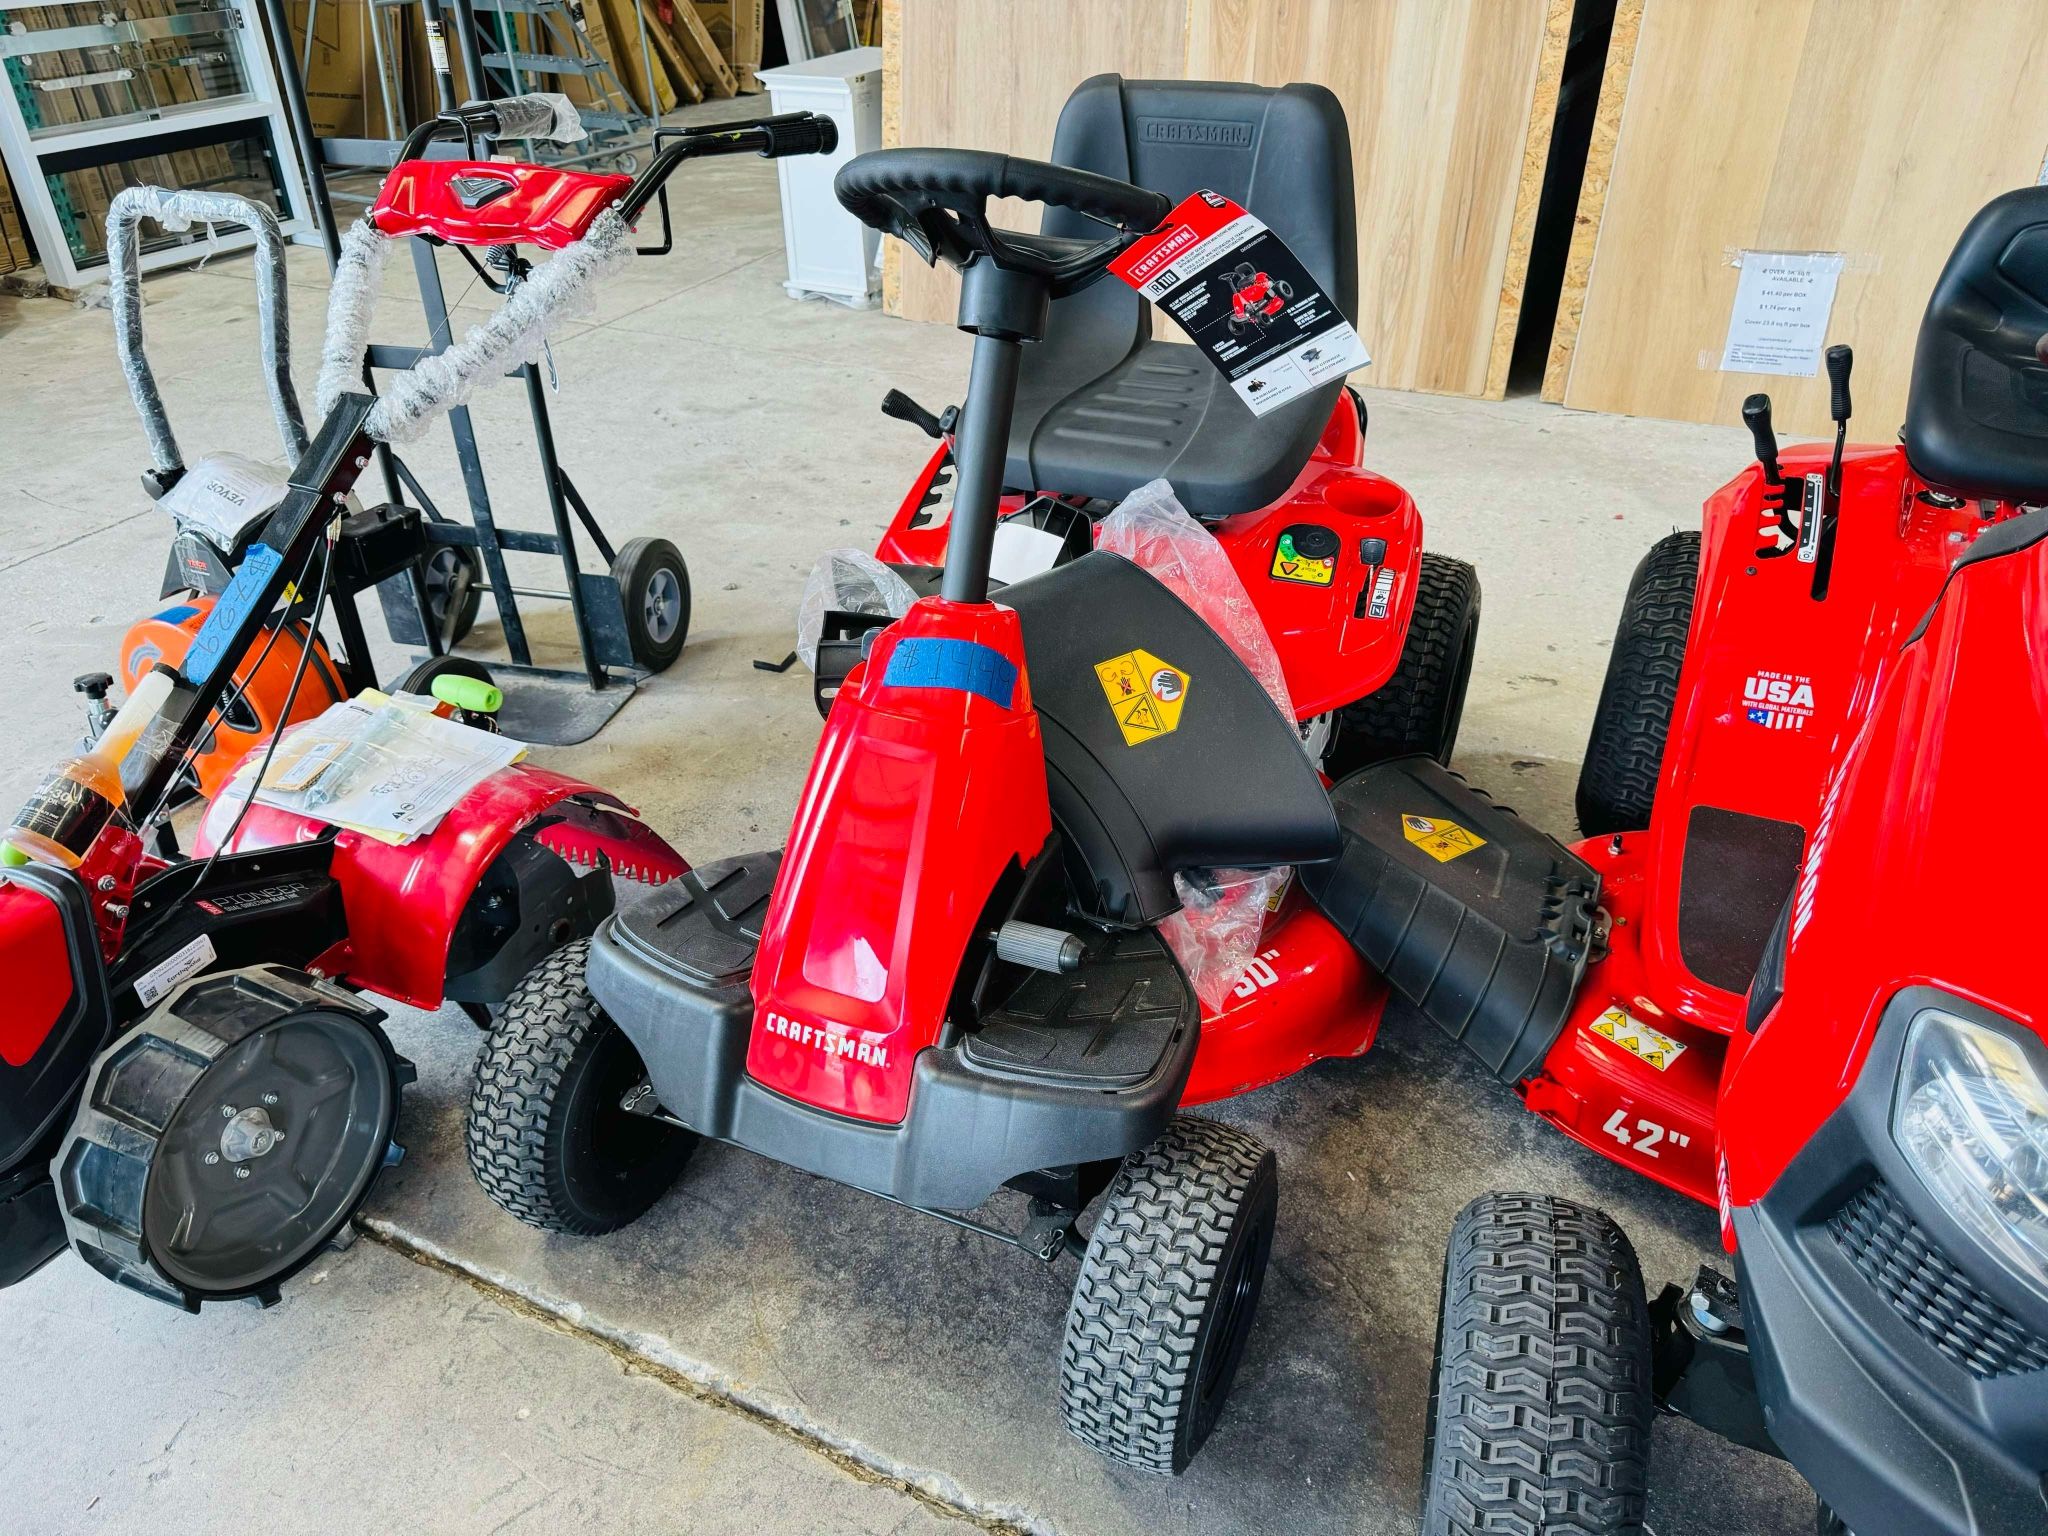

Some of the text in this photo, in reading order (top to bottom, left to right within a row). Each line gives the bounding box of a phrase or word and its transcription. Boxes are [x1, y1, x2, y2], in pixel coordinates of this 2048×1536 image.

[1146, 122, 1242, 142] CRAFTSMAN
[1134, 230, 1193, 277] CRAFTSMAN
[207, 480, 247, 506] VEVOR
[903, 642, 1011, 696] $1449
[1757, 670, 1781, 680] MADE
[1795, 675, 1811, 684] THE
[1744, 677, 1814, 708] USA
[1742, 700, 1814, 716] WITH GLOBAL MATERIALS
[211, 883, 309, 907] PIONEER
[766, 1012, 888, 1067] CRAFTSMAN
[1602, 1109, 1690, 1159] 42"
